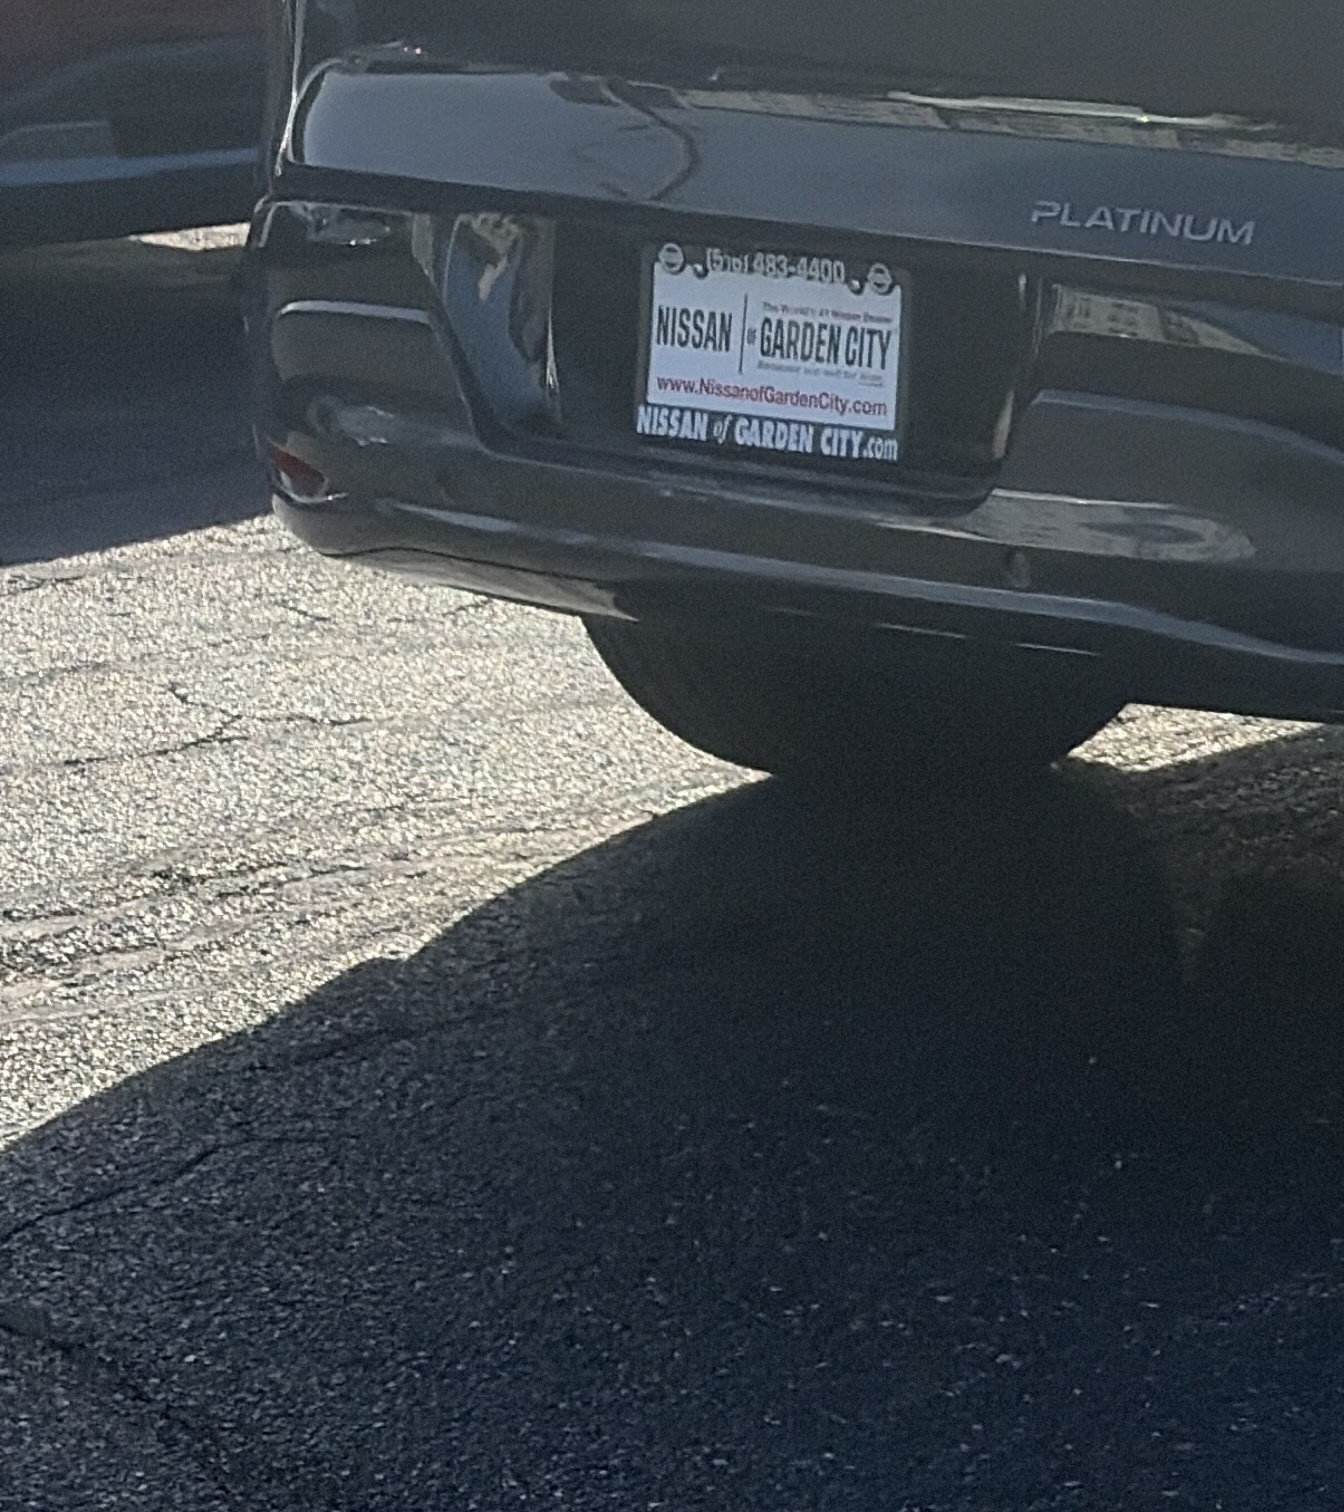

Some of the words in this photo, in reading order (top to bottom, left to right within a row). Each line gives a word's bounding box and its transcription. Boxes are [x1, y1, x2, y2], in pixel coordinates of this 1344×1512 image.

[1031, 200, 1256, 245] PLATINUM
[656, 305, 733, 353] NISSAN
[760, 316, 841, 365] GARDEN
[845, 325, 892, 371] CITY
[636, 404, 709, 442] NISSAN
[713, 414, 733, 445] of
[734, 417, 814, 454] GARDEN
